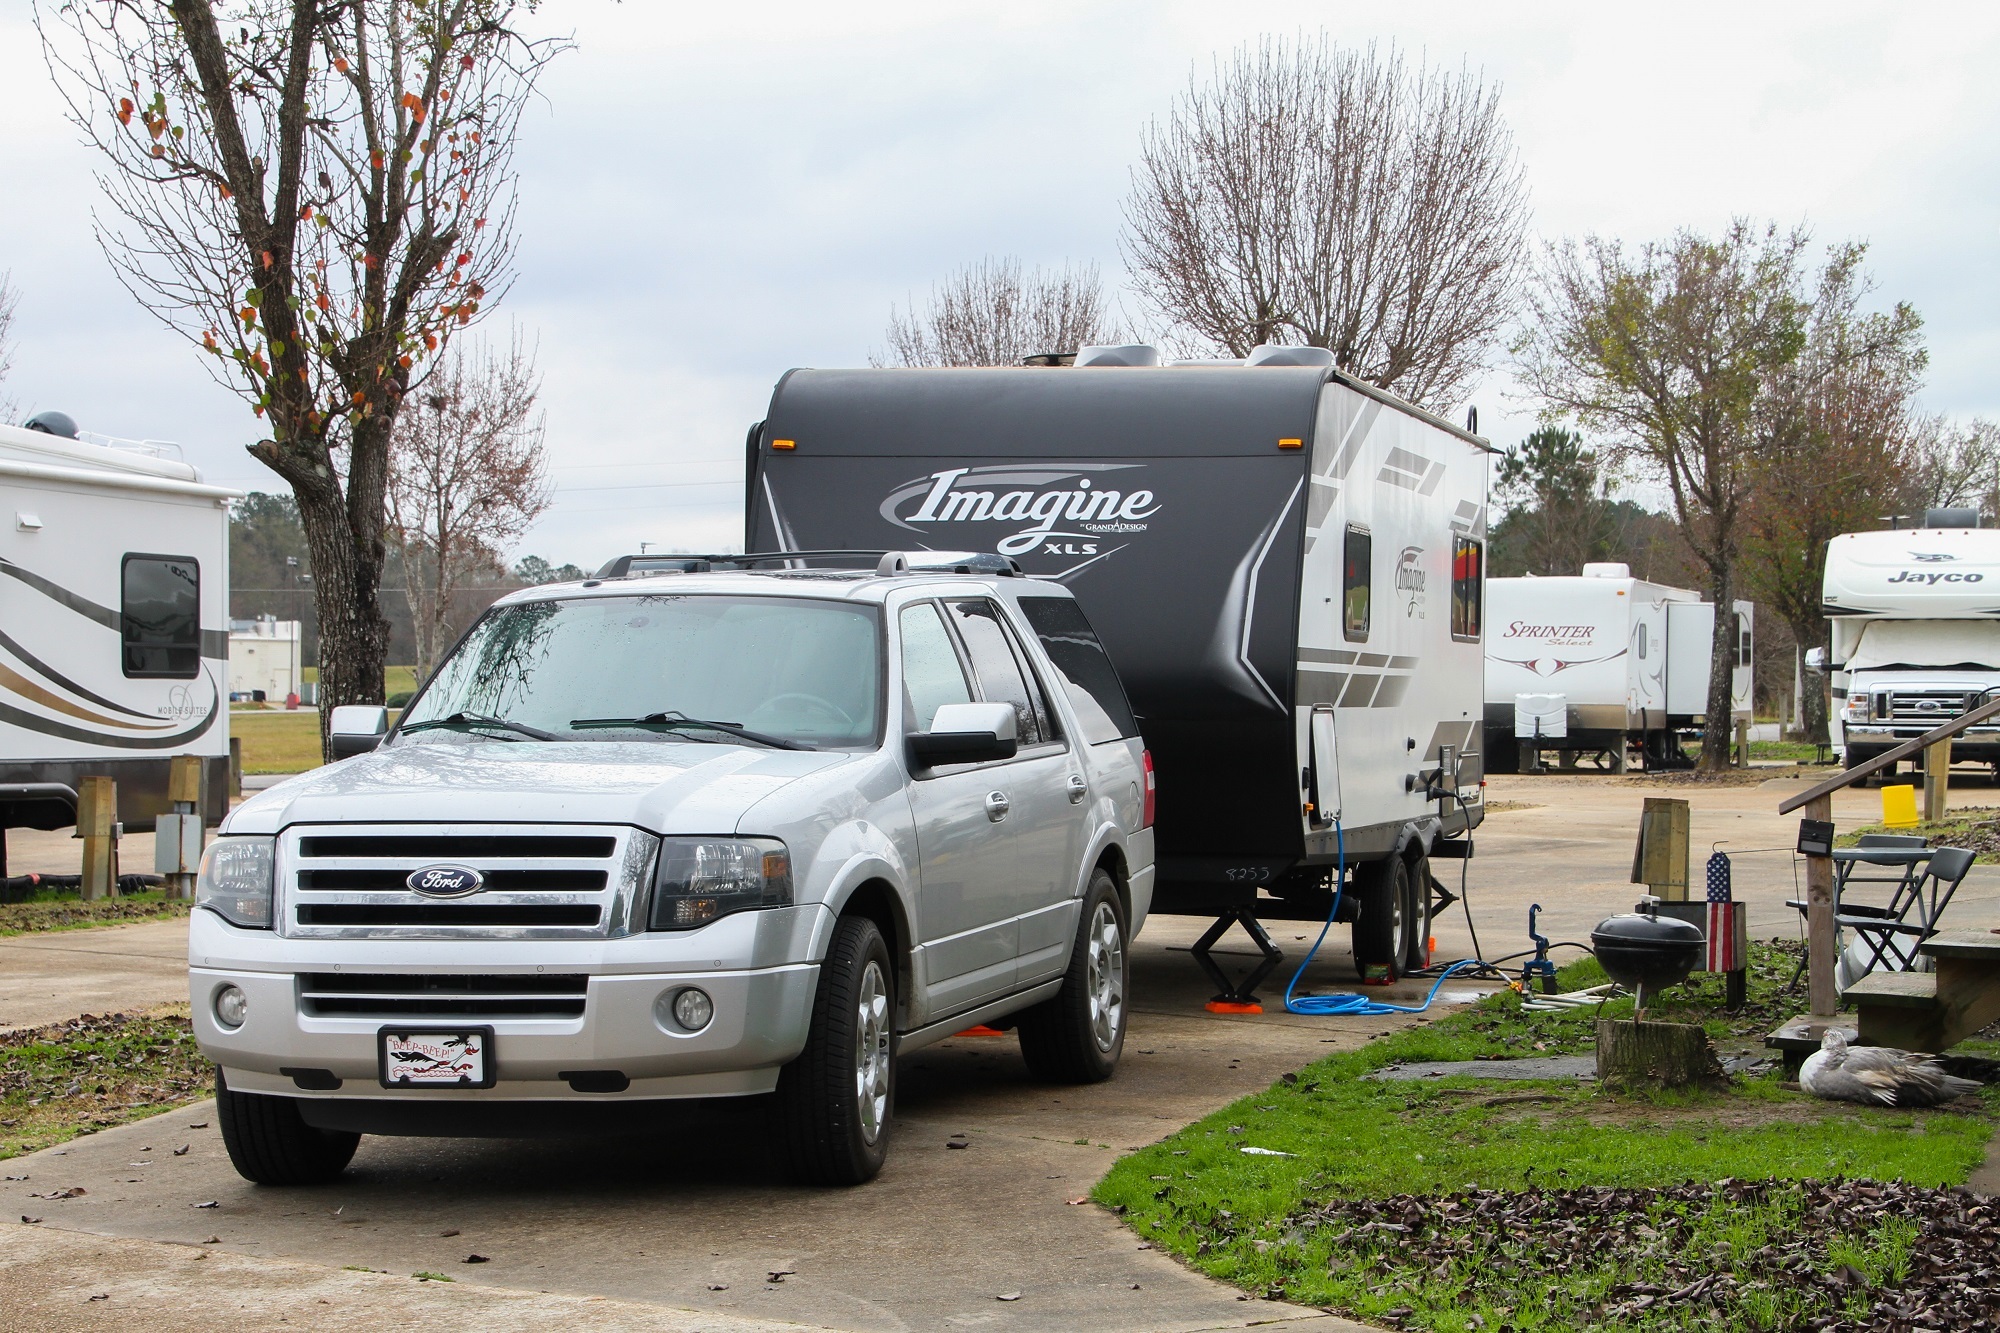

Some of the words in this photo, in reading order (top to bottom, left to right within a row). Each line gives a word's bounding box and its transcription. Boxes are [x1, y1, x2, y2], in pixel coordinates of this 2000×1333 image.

[905, 467, 1163, 556] Imagine
[1085, 523, 1114, 531] GRAND
[1120, 523, 1148, 531] DESIGN
[1043, 543, 1098, 555] XLS
[1398, 549, 1426, 618] Imagine
[1888, 571, 1984, 586] Jayco
[1503, 620, 1595, 638] SPRINTER
[1544, 638, 1594, 646] Select
[158, 706, 182, 715] MOBILE
[184, 706, 208, 715] SUITES
[421, 870, 465, 889] Ford
